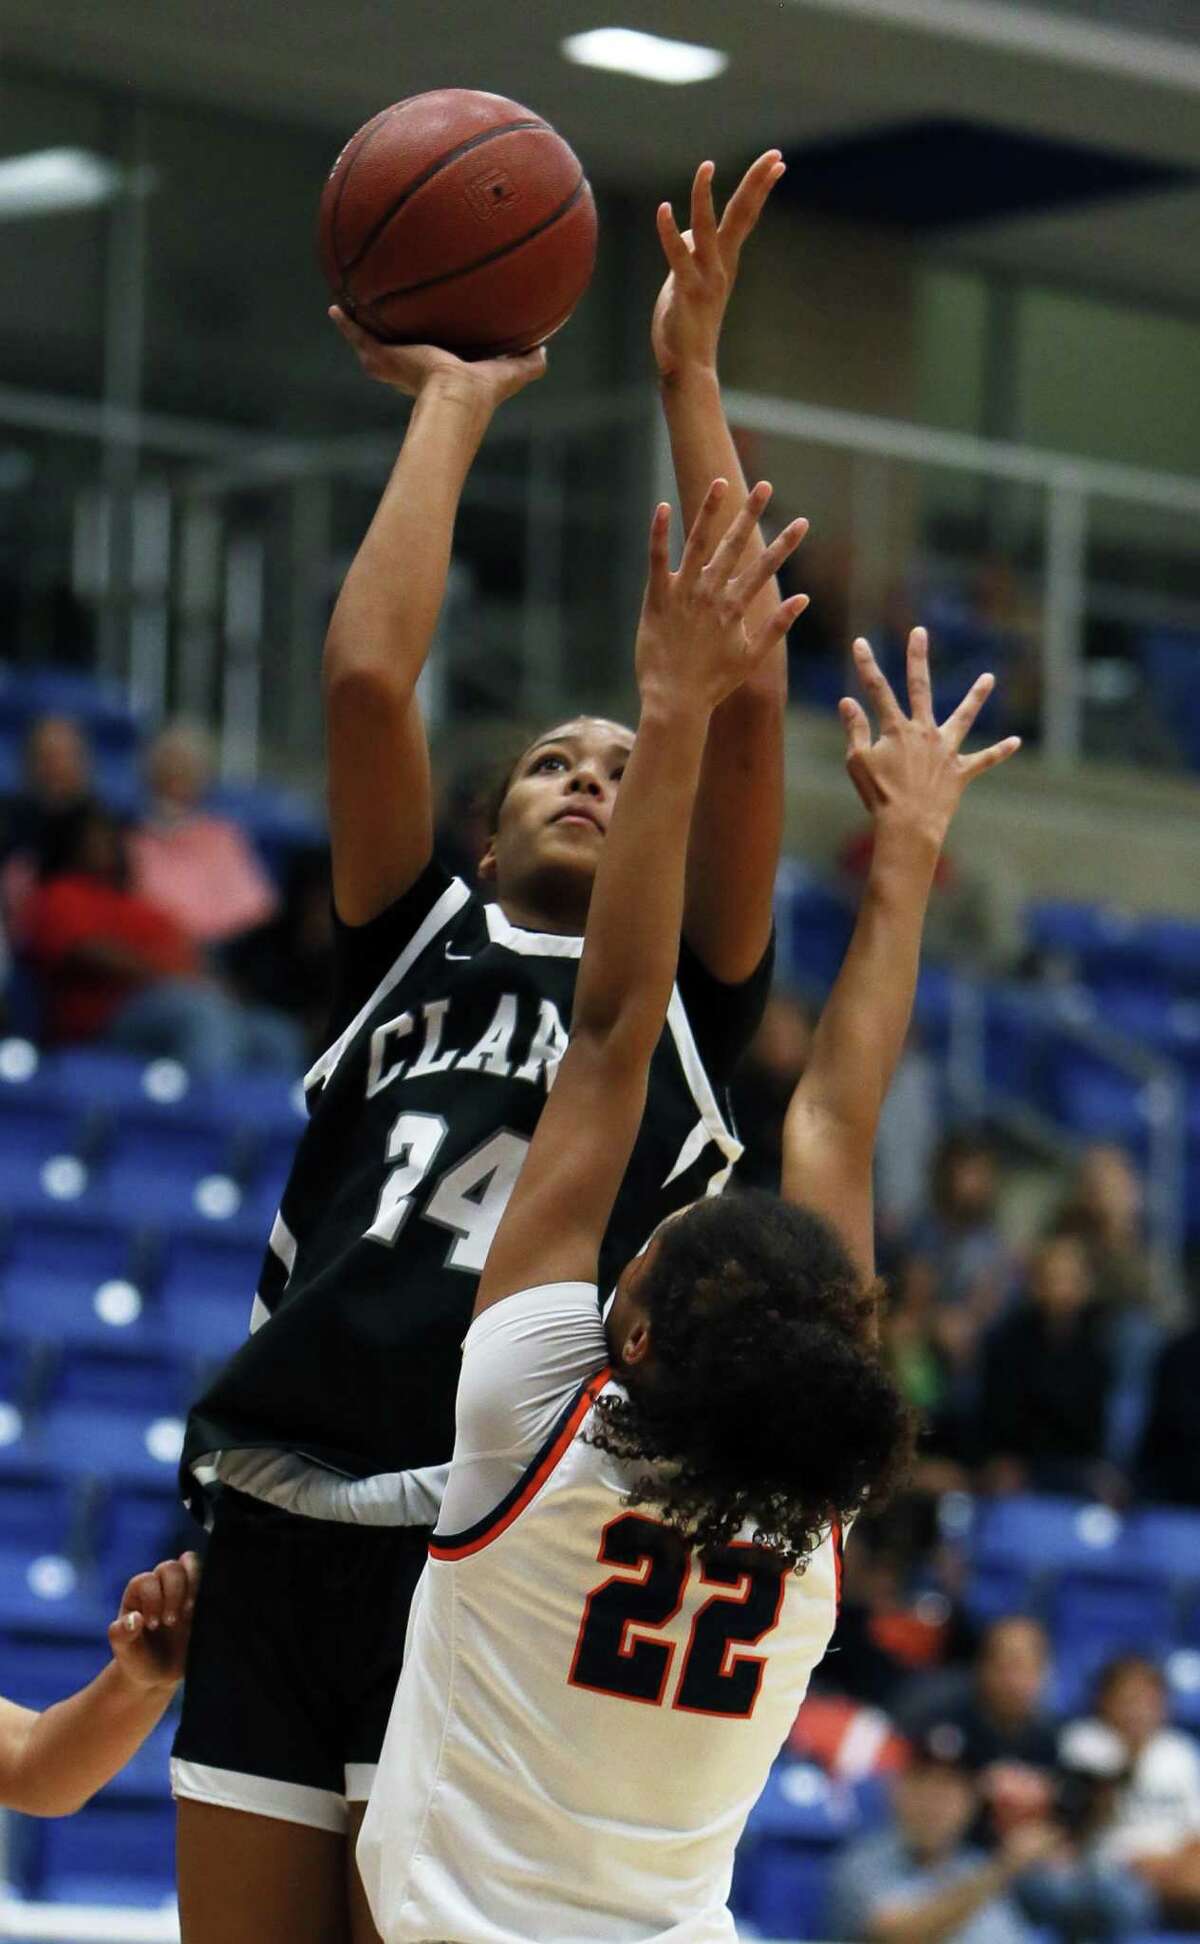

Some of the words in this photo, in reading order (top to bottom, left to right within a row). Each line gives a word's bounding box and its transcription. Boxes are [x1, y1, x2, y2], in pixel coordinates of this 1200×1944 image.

[366, 993, 569, 1099] CLAR
[362, 1110, 531, 1276] 24
[567, 1511, 796, 1720] 22
